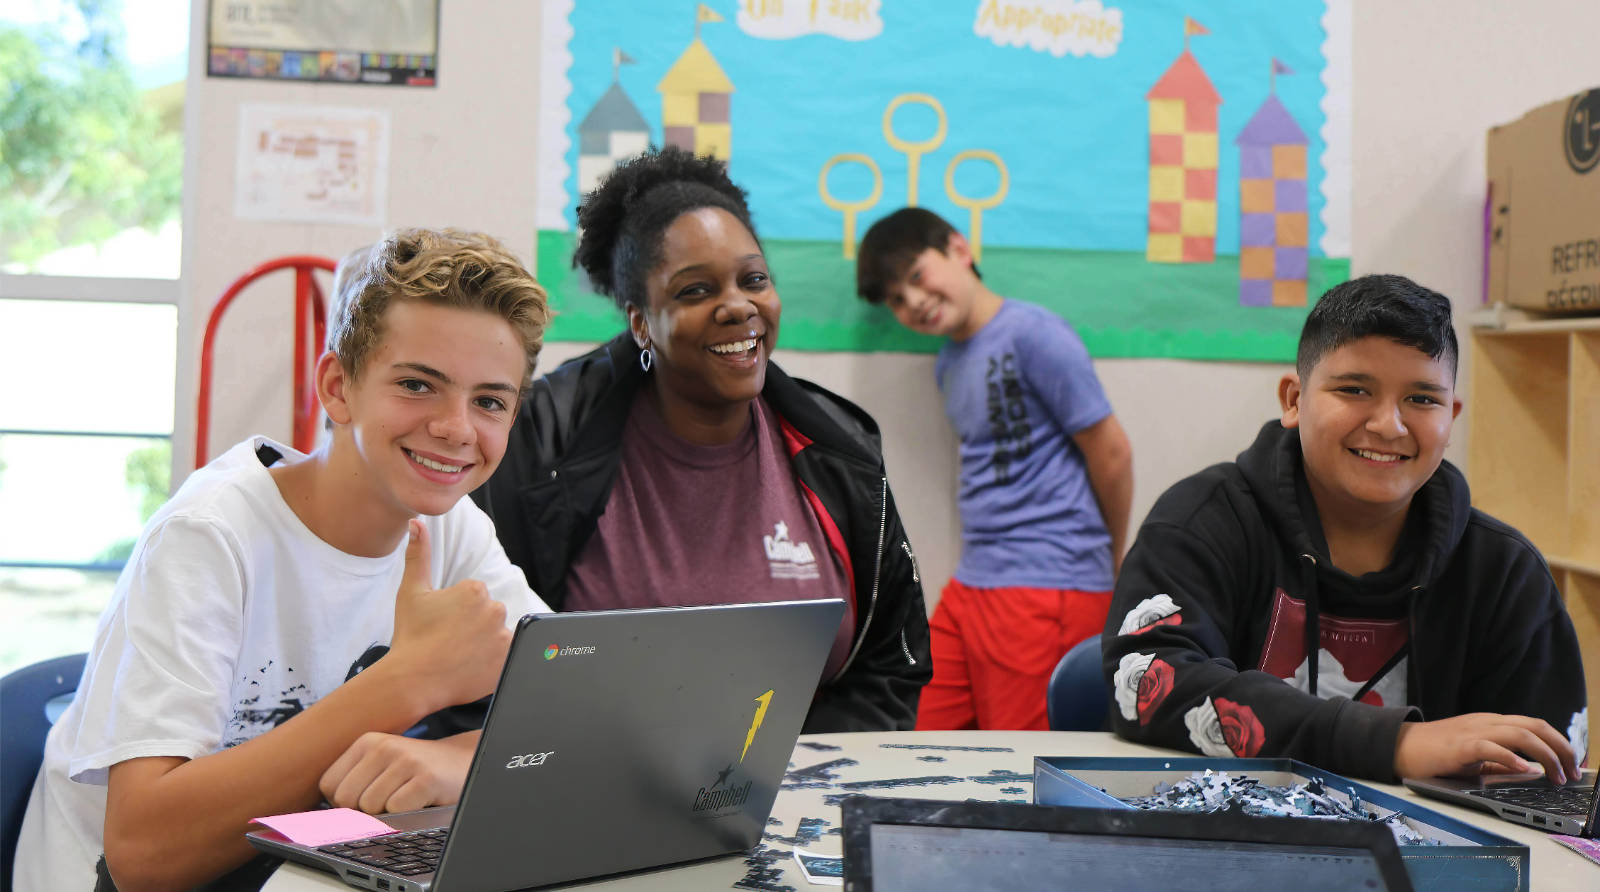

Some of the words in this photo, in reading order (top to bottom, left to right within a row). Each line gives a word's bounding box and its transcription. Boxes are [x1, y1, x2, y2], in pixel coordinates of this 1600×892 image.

[978, 0, 1119, 44] Appropriate
[1552, 237, 1600, 275] REFR
[560, 644, 596, 656] chrome
[505, 750, 555, 769] acer
[692, 780, 753, 812] Campbell
